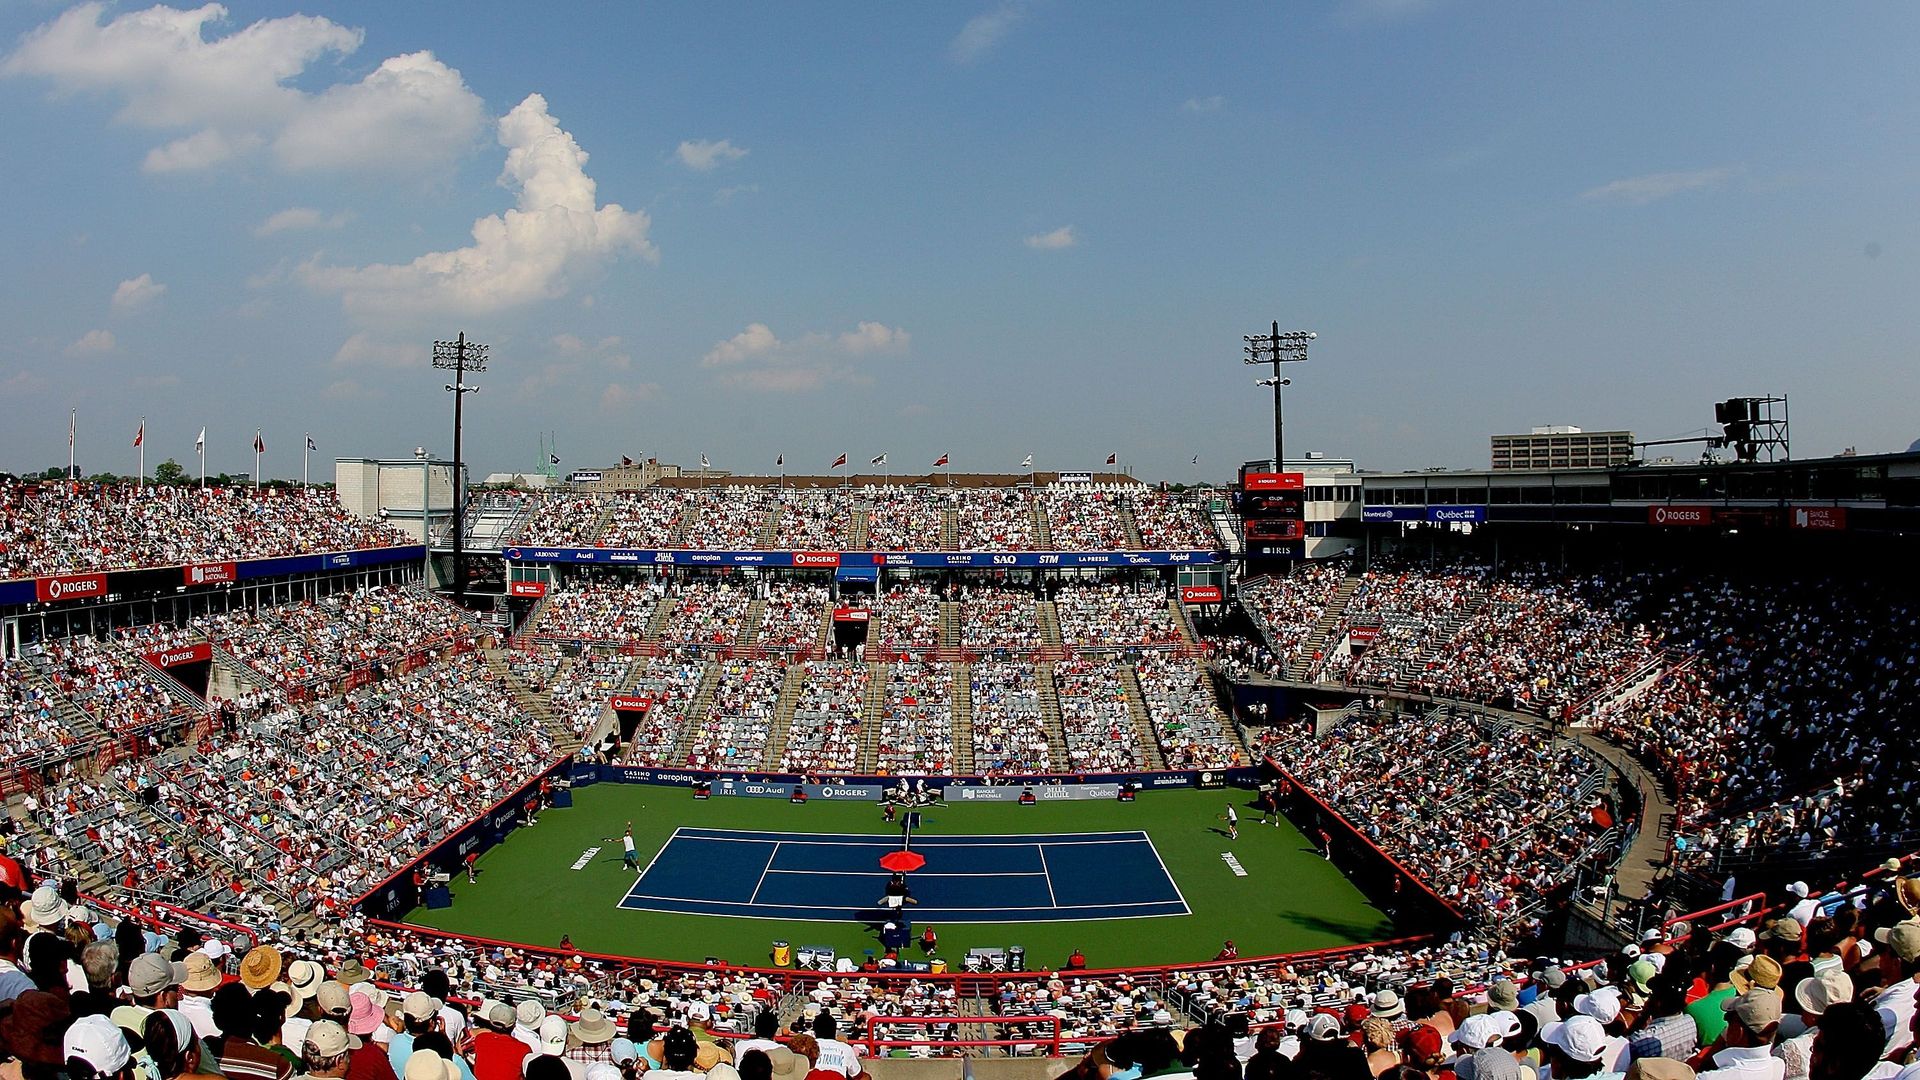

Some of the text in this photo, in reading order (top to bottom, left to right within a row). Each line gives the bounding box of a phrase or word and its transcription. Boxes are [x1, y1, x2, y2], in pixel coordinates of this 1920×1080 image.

[1436, 510, 1464, 519] Québec
[1668, 511, 1700, 520] ROGERS
[993, 555, 1017, 564] SAQ
[1039, 555, 1059, 564] STM
[1130, 556, 1151, 564] Québec
[204, 572, 229, 581] NATIONALE
[62, 581, 98, 593] ROGERS
[169, 651, 194, 662] ROGERS
[658, 773, 693, 783] aeroplan
[1089, 789, 1115, 797] Québec
